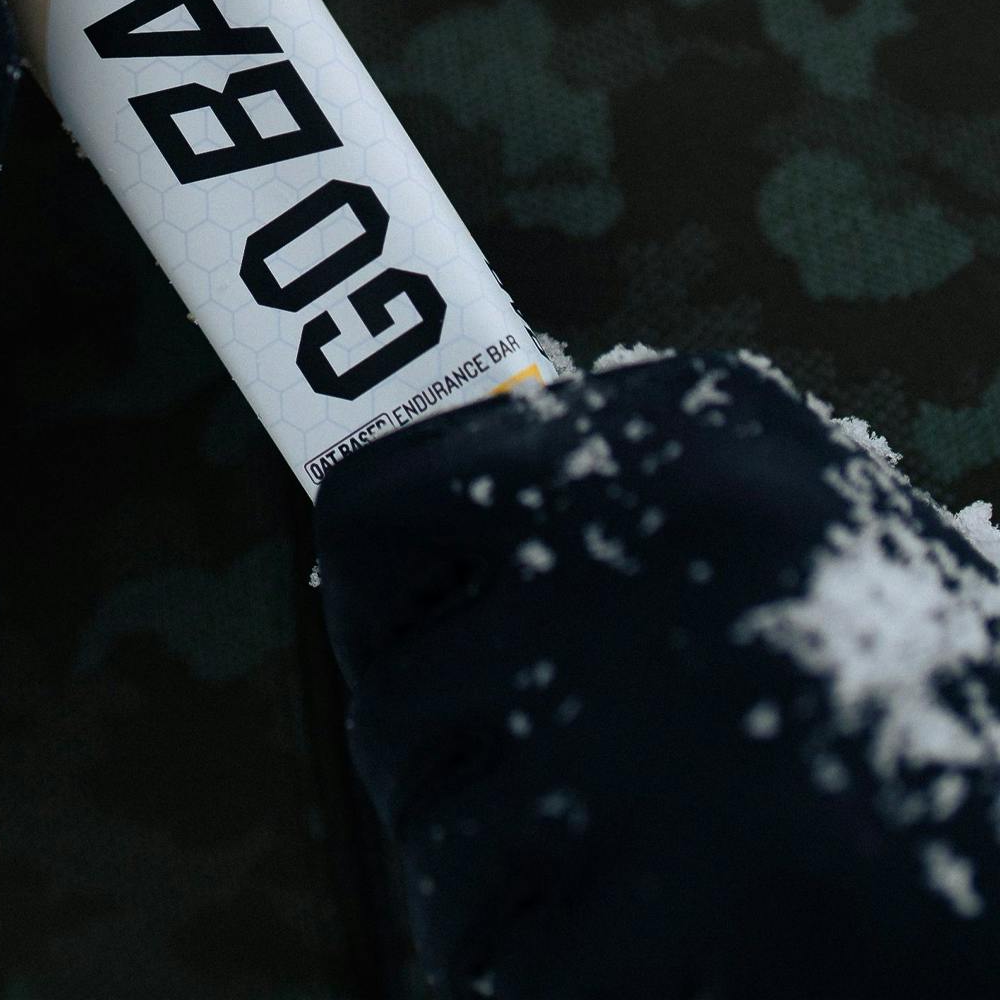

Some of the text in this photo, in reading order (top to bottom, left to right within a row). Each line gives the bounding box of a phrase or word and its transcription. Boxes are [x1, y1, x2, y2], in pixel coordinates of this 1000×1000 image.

[239, 179, 447, 400] GO
[309, 450, 339, 481] OAT
[392, 353, 489, 427] ENDURANCE
[486, 334, 521, 364] BAR
